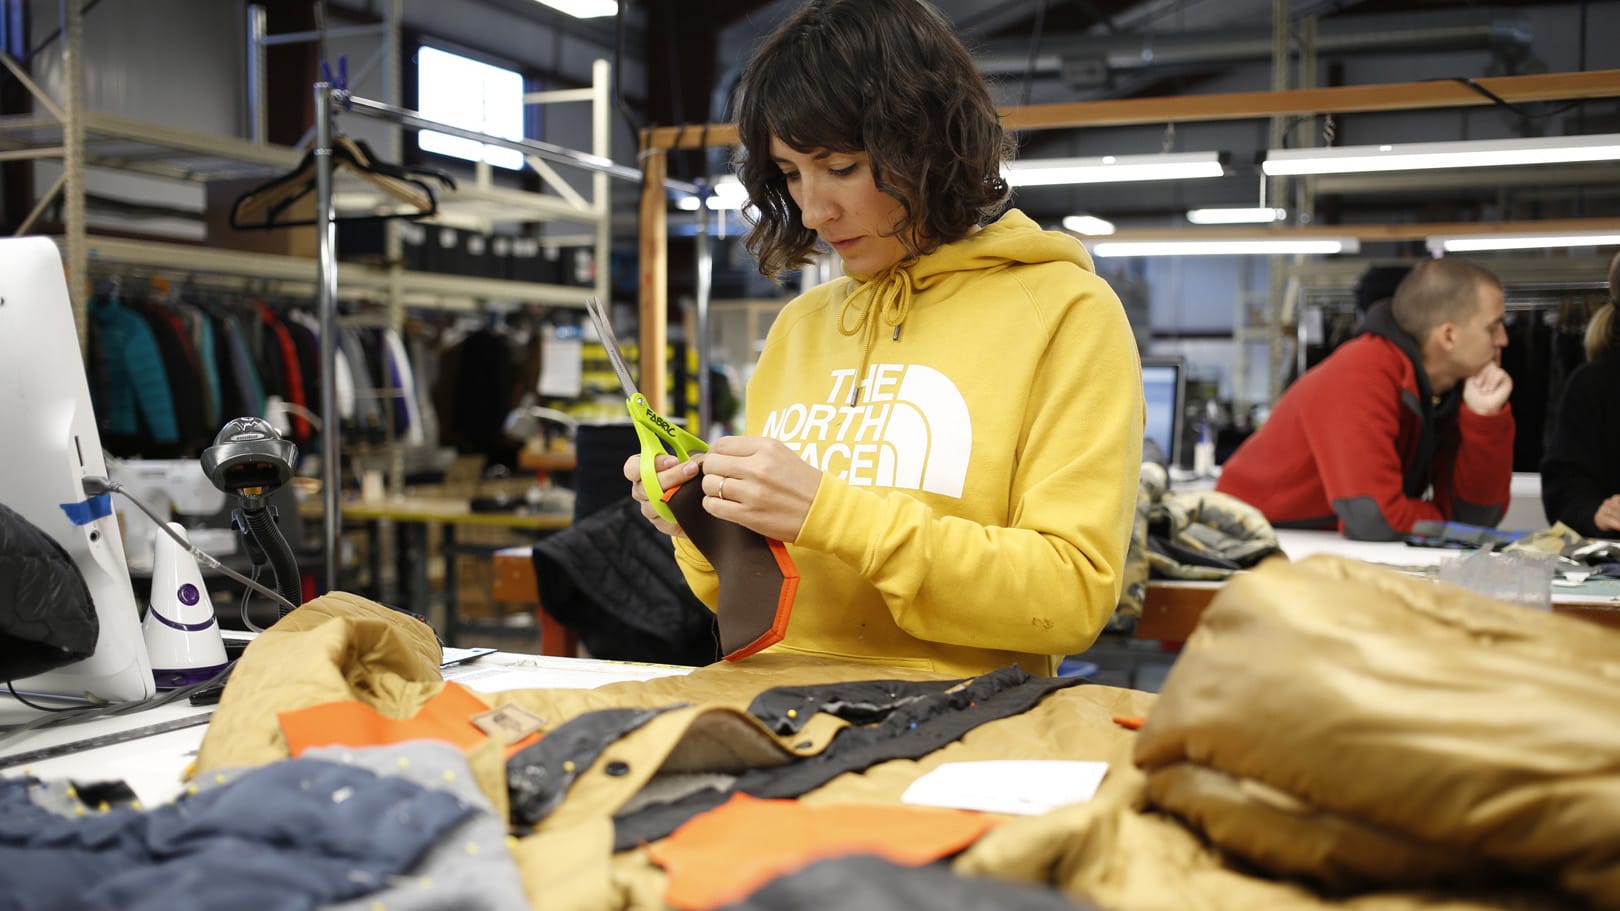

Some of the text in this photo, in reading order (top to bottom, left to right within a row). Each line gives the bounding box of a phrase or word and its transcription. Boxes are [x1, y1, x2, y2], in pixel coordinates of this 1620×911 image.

[827, 364, 904, 404] THE
[646, 408, 676, 437] FABRIC
[762, 403, 889, 442] NORTH
[784, 442, 878, 487] ACE
